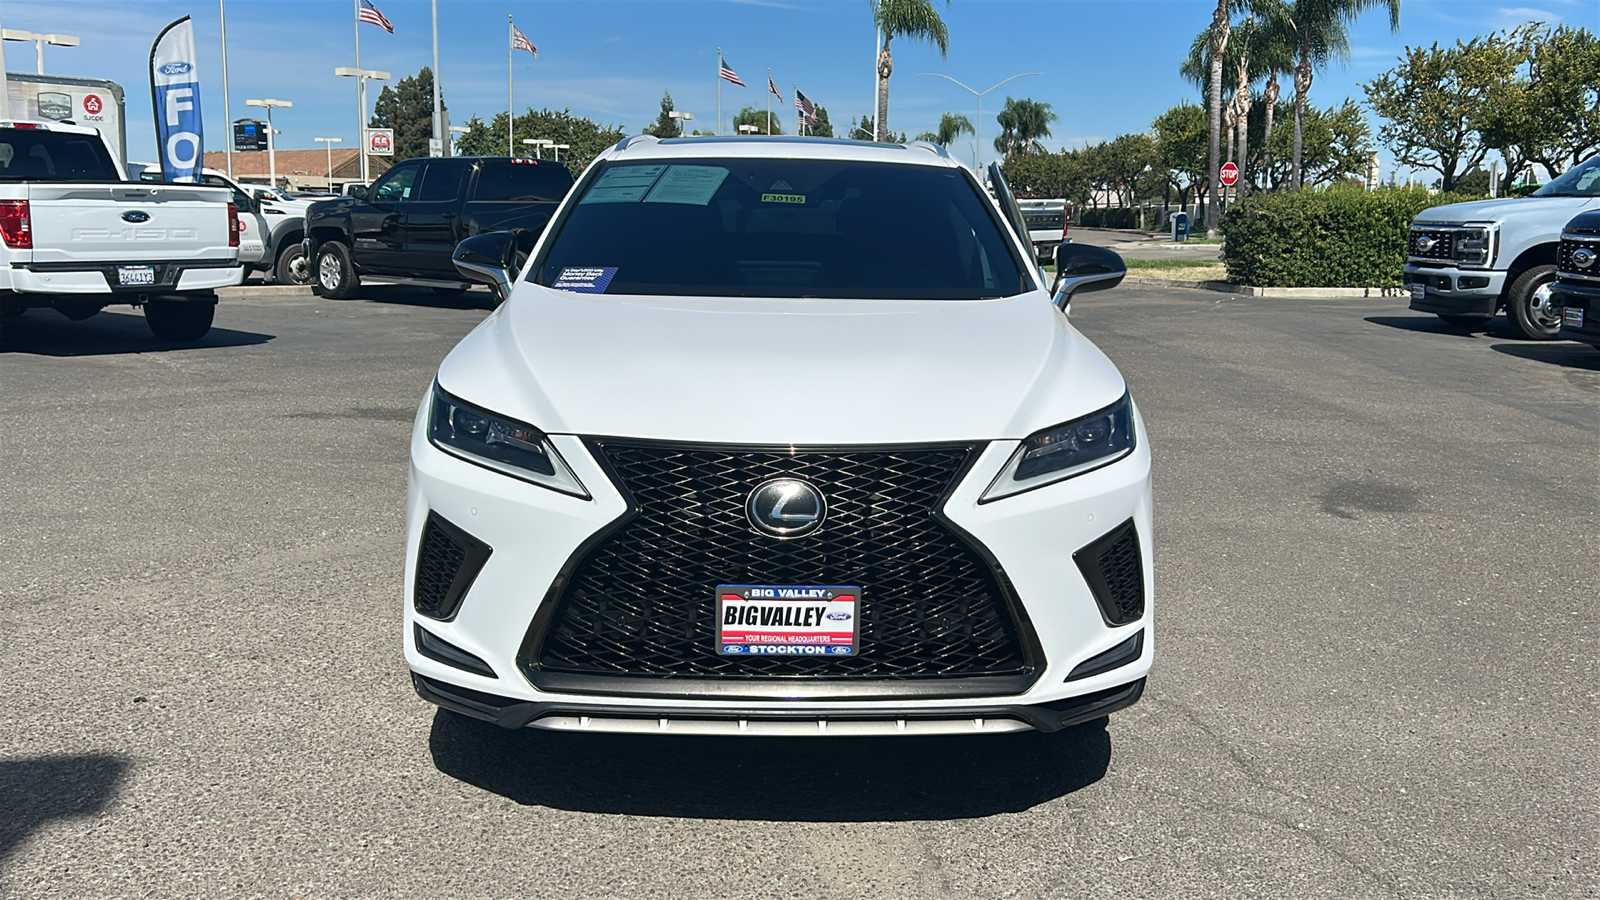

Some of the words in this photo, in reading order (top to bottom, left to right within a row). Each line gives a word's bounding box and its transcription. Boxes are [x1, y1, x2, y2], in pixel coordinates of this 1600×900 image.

[162, 63, 190, 74] Ford
[166, 88, 200, 184] FO
[374, 137, 387, 147] 55
[1221, 170, 1237, 178] STOP
[71, 228, 198, 240] F-150
[751, 589, 774, 597] BIG
[779, 589, 826, 598] VALLEY
[724, 606, 826, 626] BIGVALLEY
